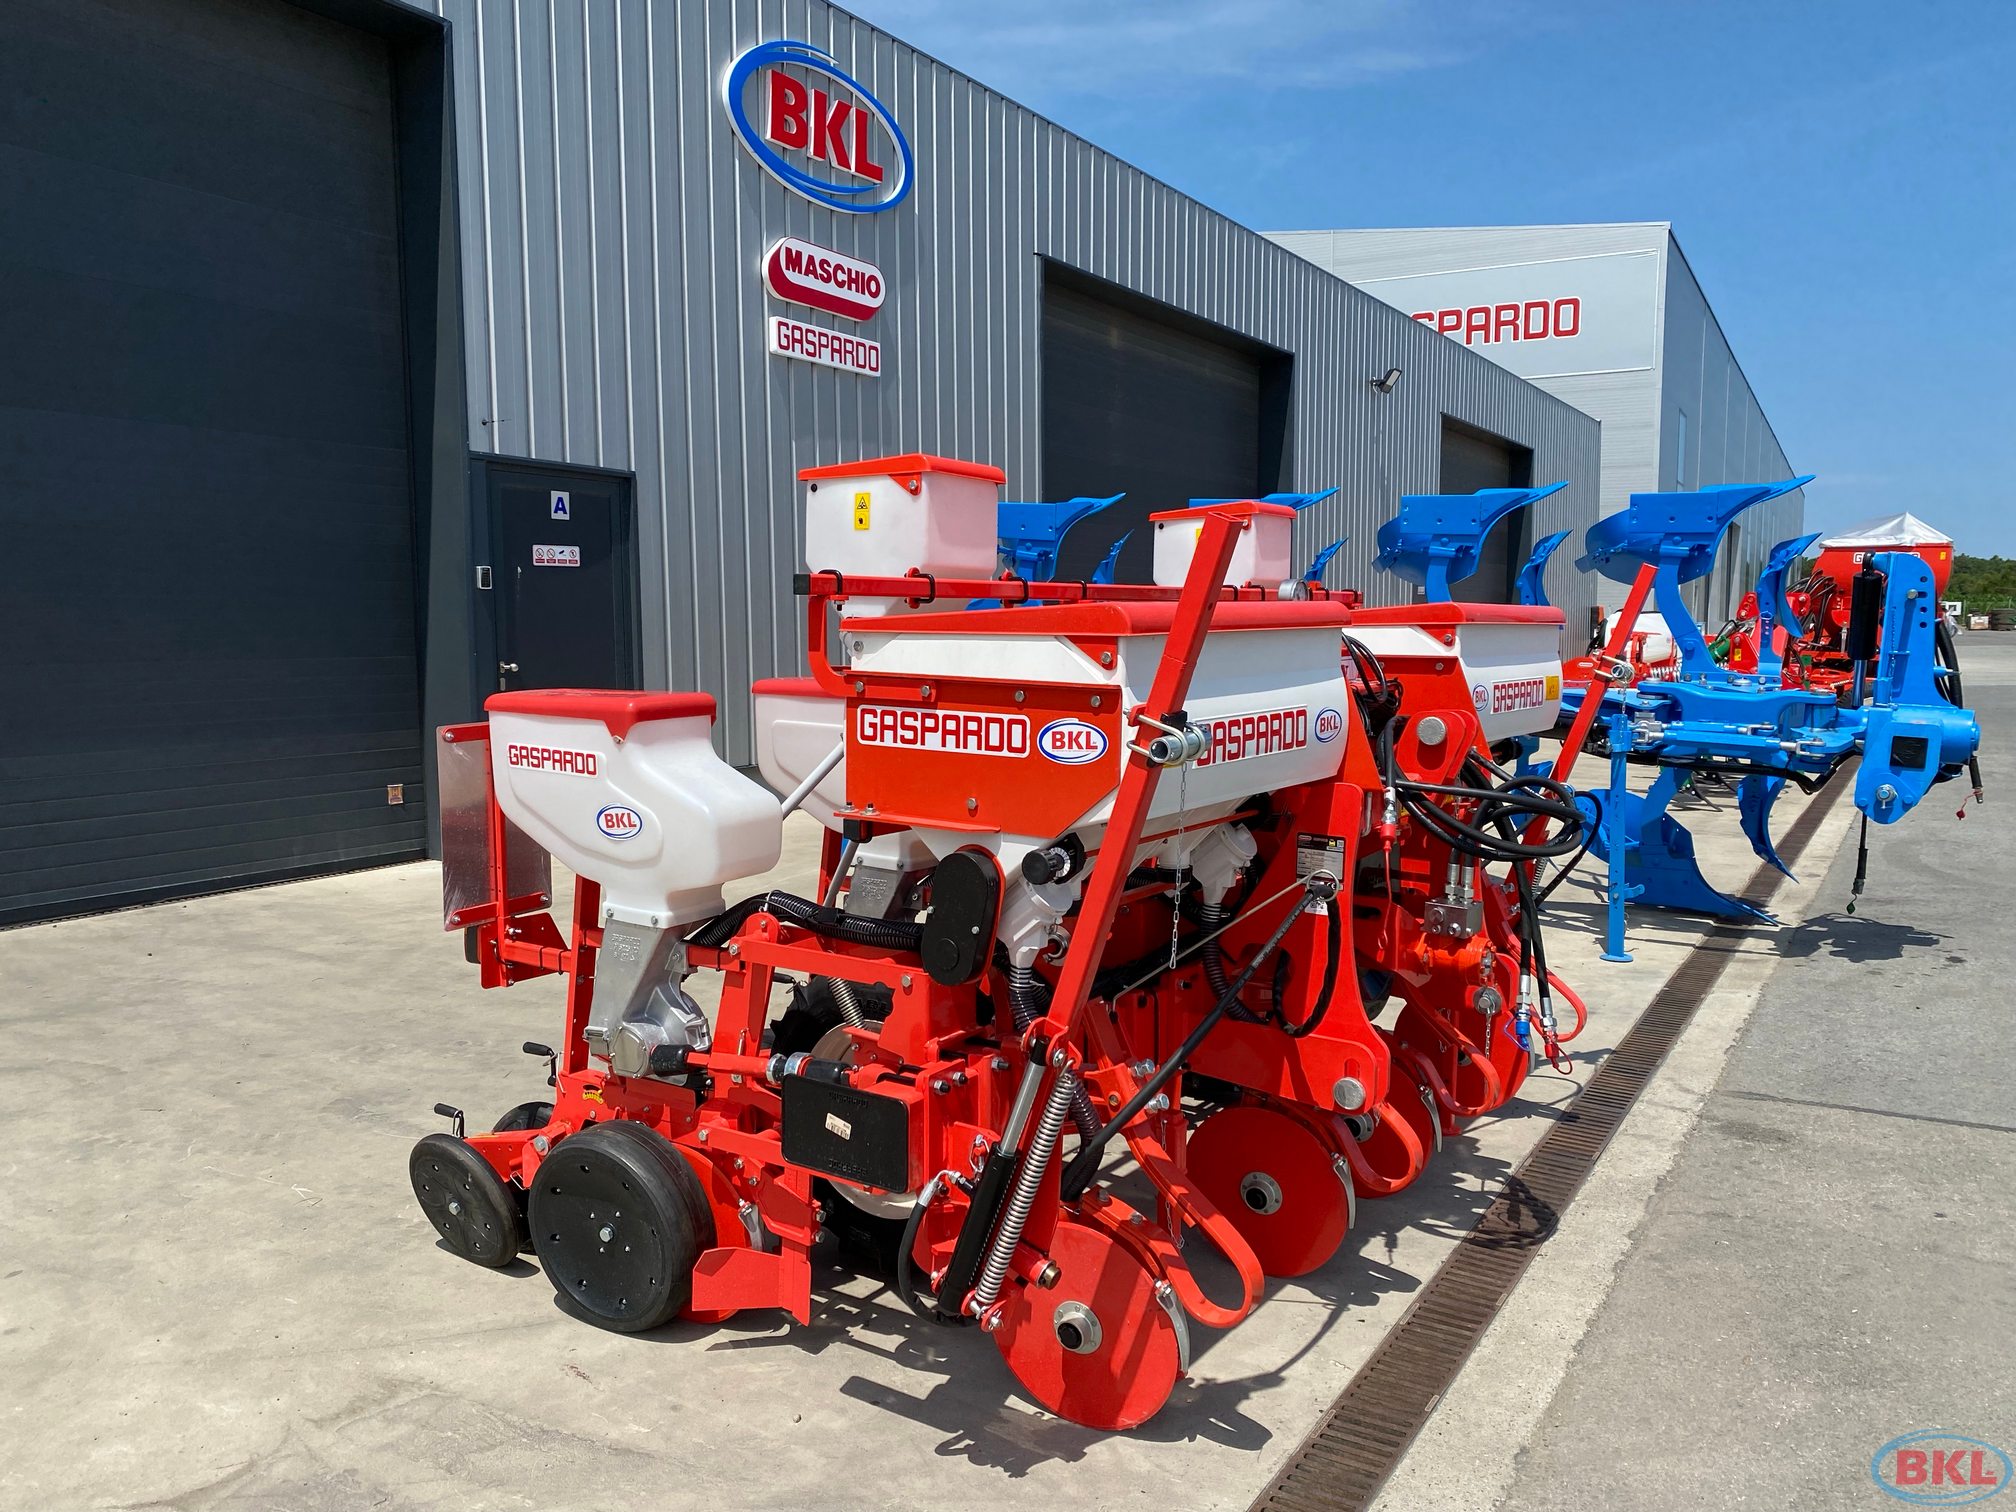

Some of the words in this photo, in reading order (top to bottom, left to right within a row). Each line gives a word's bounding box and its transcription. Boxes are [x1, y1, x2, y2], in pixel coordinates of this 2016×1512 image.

[766, 69, 883, 184] BKL
[785, 247, 880, 298] MASCHIO
[777, 320, 880, 373] GASPARDO
[553, 496, 567, 514] A
[1493, 679, 1544, 713] GASPARDO
[860, 708, 1028, 753] GASPARDO
[1051, 730, 1098, 749] BKL
[1319, 714, 1338, 733] BKL
[508, 744, 597, 776] GASPARDO
[604, 812, 637, 829] BKL
